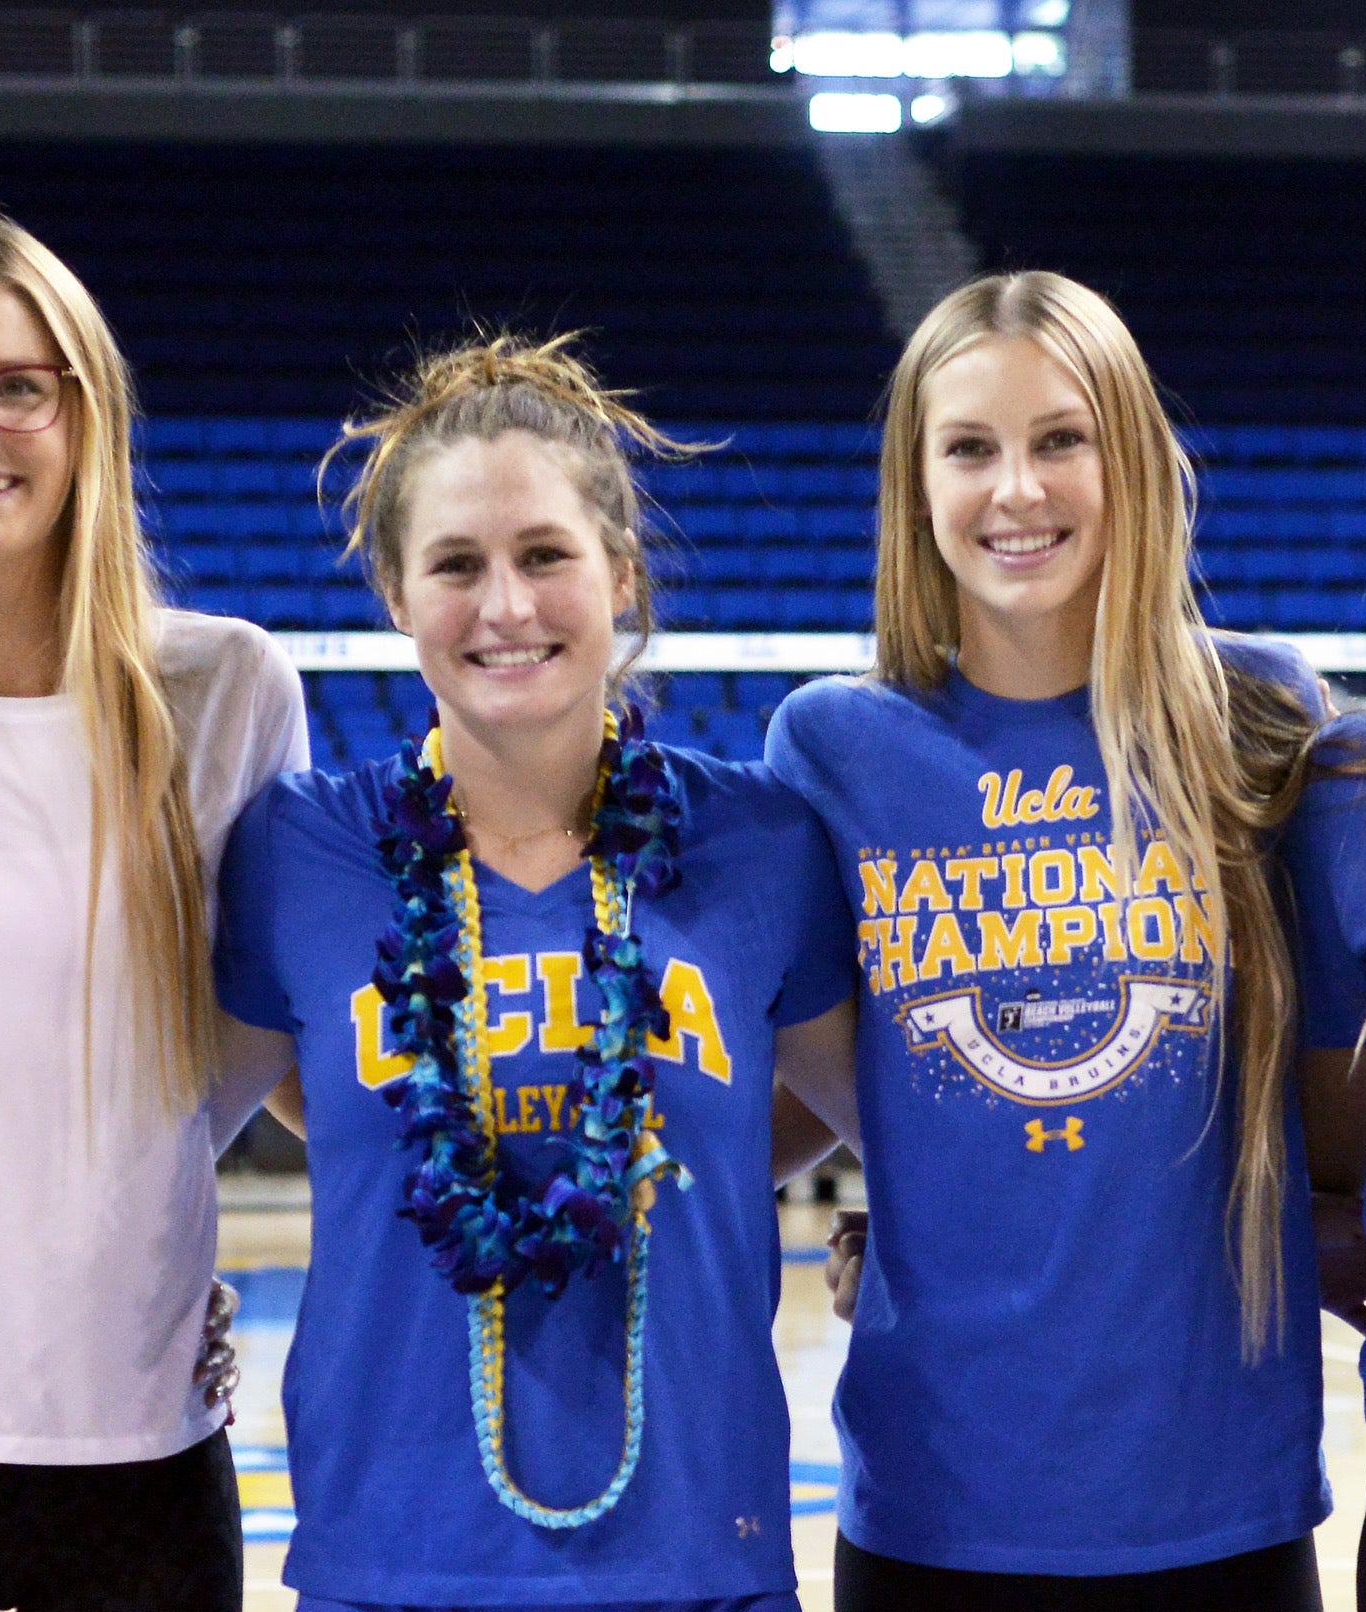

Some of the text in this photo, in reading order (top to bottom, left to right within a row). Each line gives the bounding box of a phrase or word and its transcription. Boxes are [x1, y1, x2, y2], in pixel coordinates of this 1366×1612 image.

[978, 764, 1099, 829] Ucla
[982, 835, 1051, 856] BEACH
[858, 841, 1209, 917] NATIONA
[857, 896, 1227, 997] CHAMPION
[967, 1027, 1141, 1091] UCLA BRUINS
